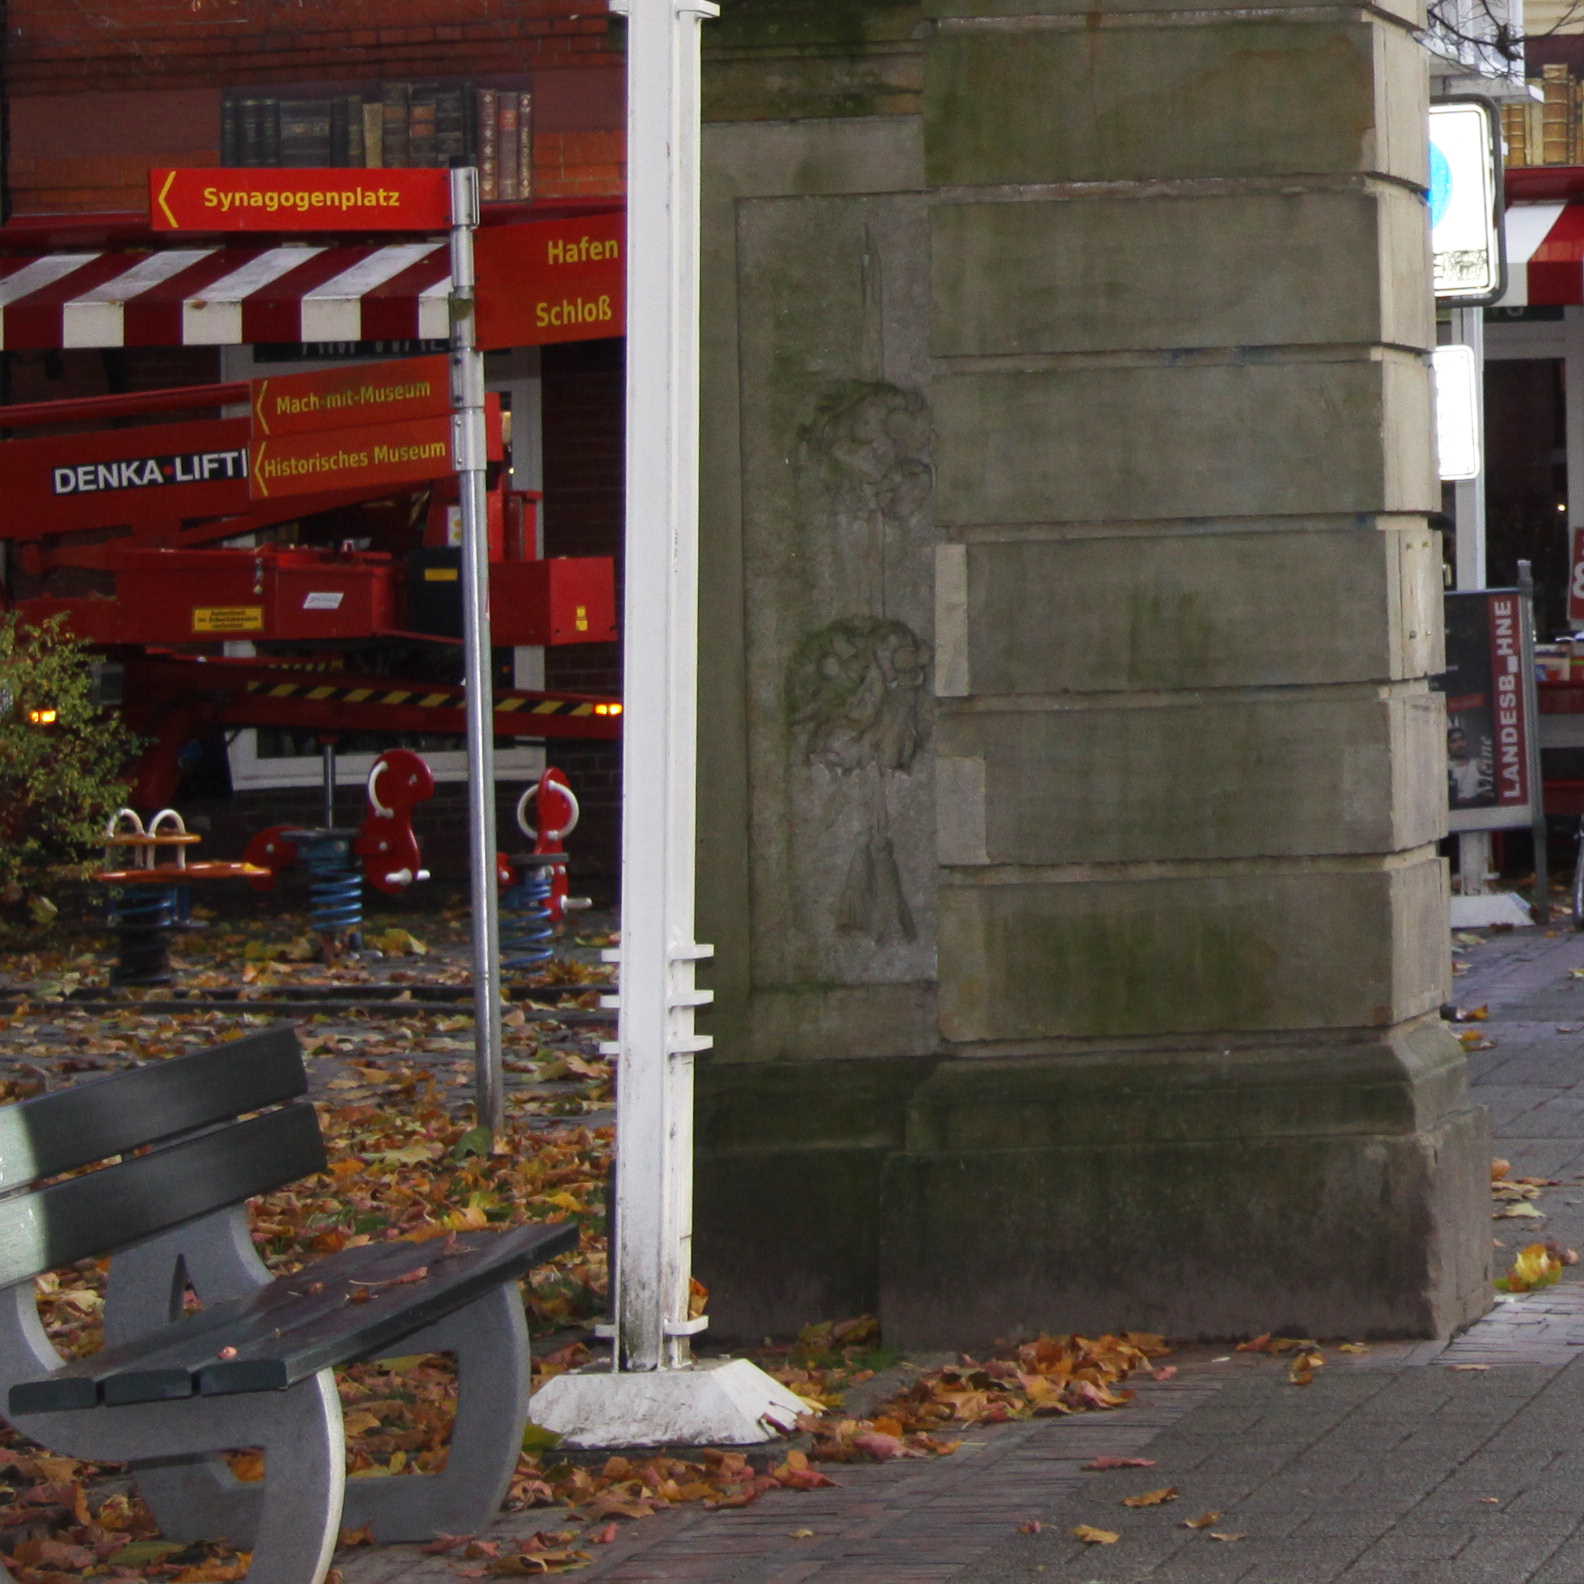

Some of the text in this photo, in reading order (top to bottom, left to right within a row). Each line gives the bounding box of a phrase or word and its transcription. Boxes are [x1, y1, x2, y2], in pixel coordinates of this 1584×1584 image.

[203, 186, 401, 211] Synagogenplatz
[547, 237, 619, 265] Hafen
[535, 295, 613, 328] Schloß
[276, 381, 431, 415] Mach-mit-Museum
[54, 451, 239, 494] DENKA LIFT
[264, 441, 446, 478] Historisches Museum
